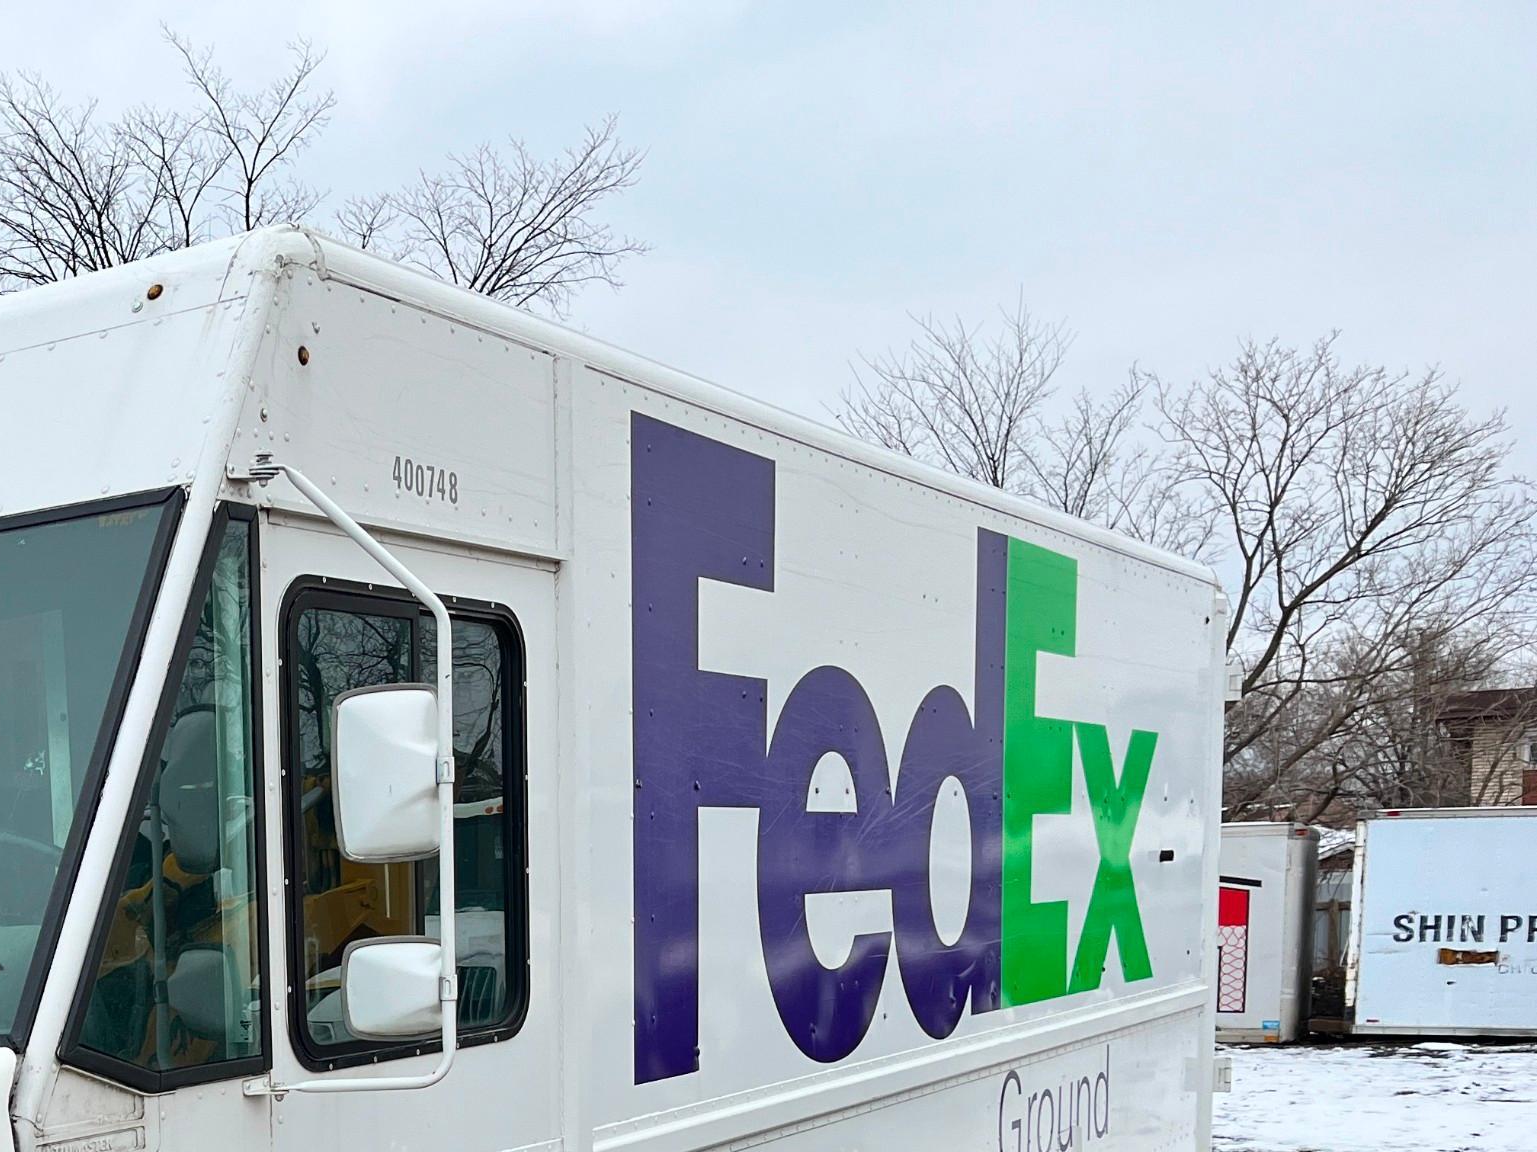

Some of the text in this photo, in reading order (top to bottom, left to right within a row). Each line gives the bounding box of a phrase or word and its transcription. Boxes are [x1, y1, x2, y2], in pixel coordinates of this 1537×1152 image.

[392, 455, 458, 505] 400748
[630, 410, 1158, 1085] FedEx
[1393, 914, 1485, 943] SHIN
